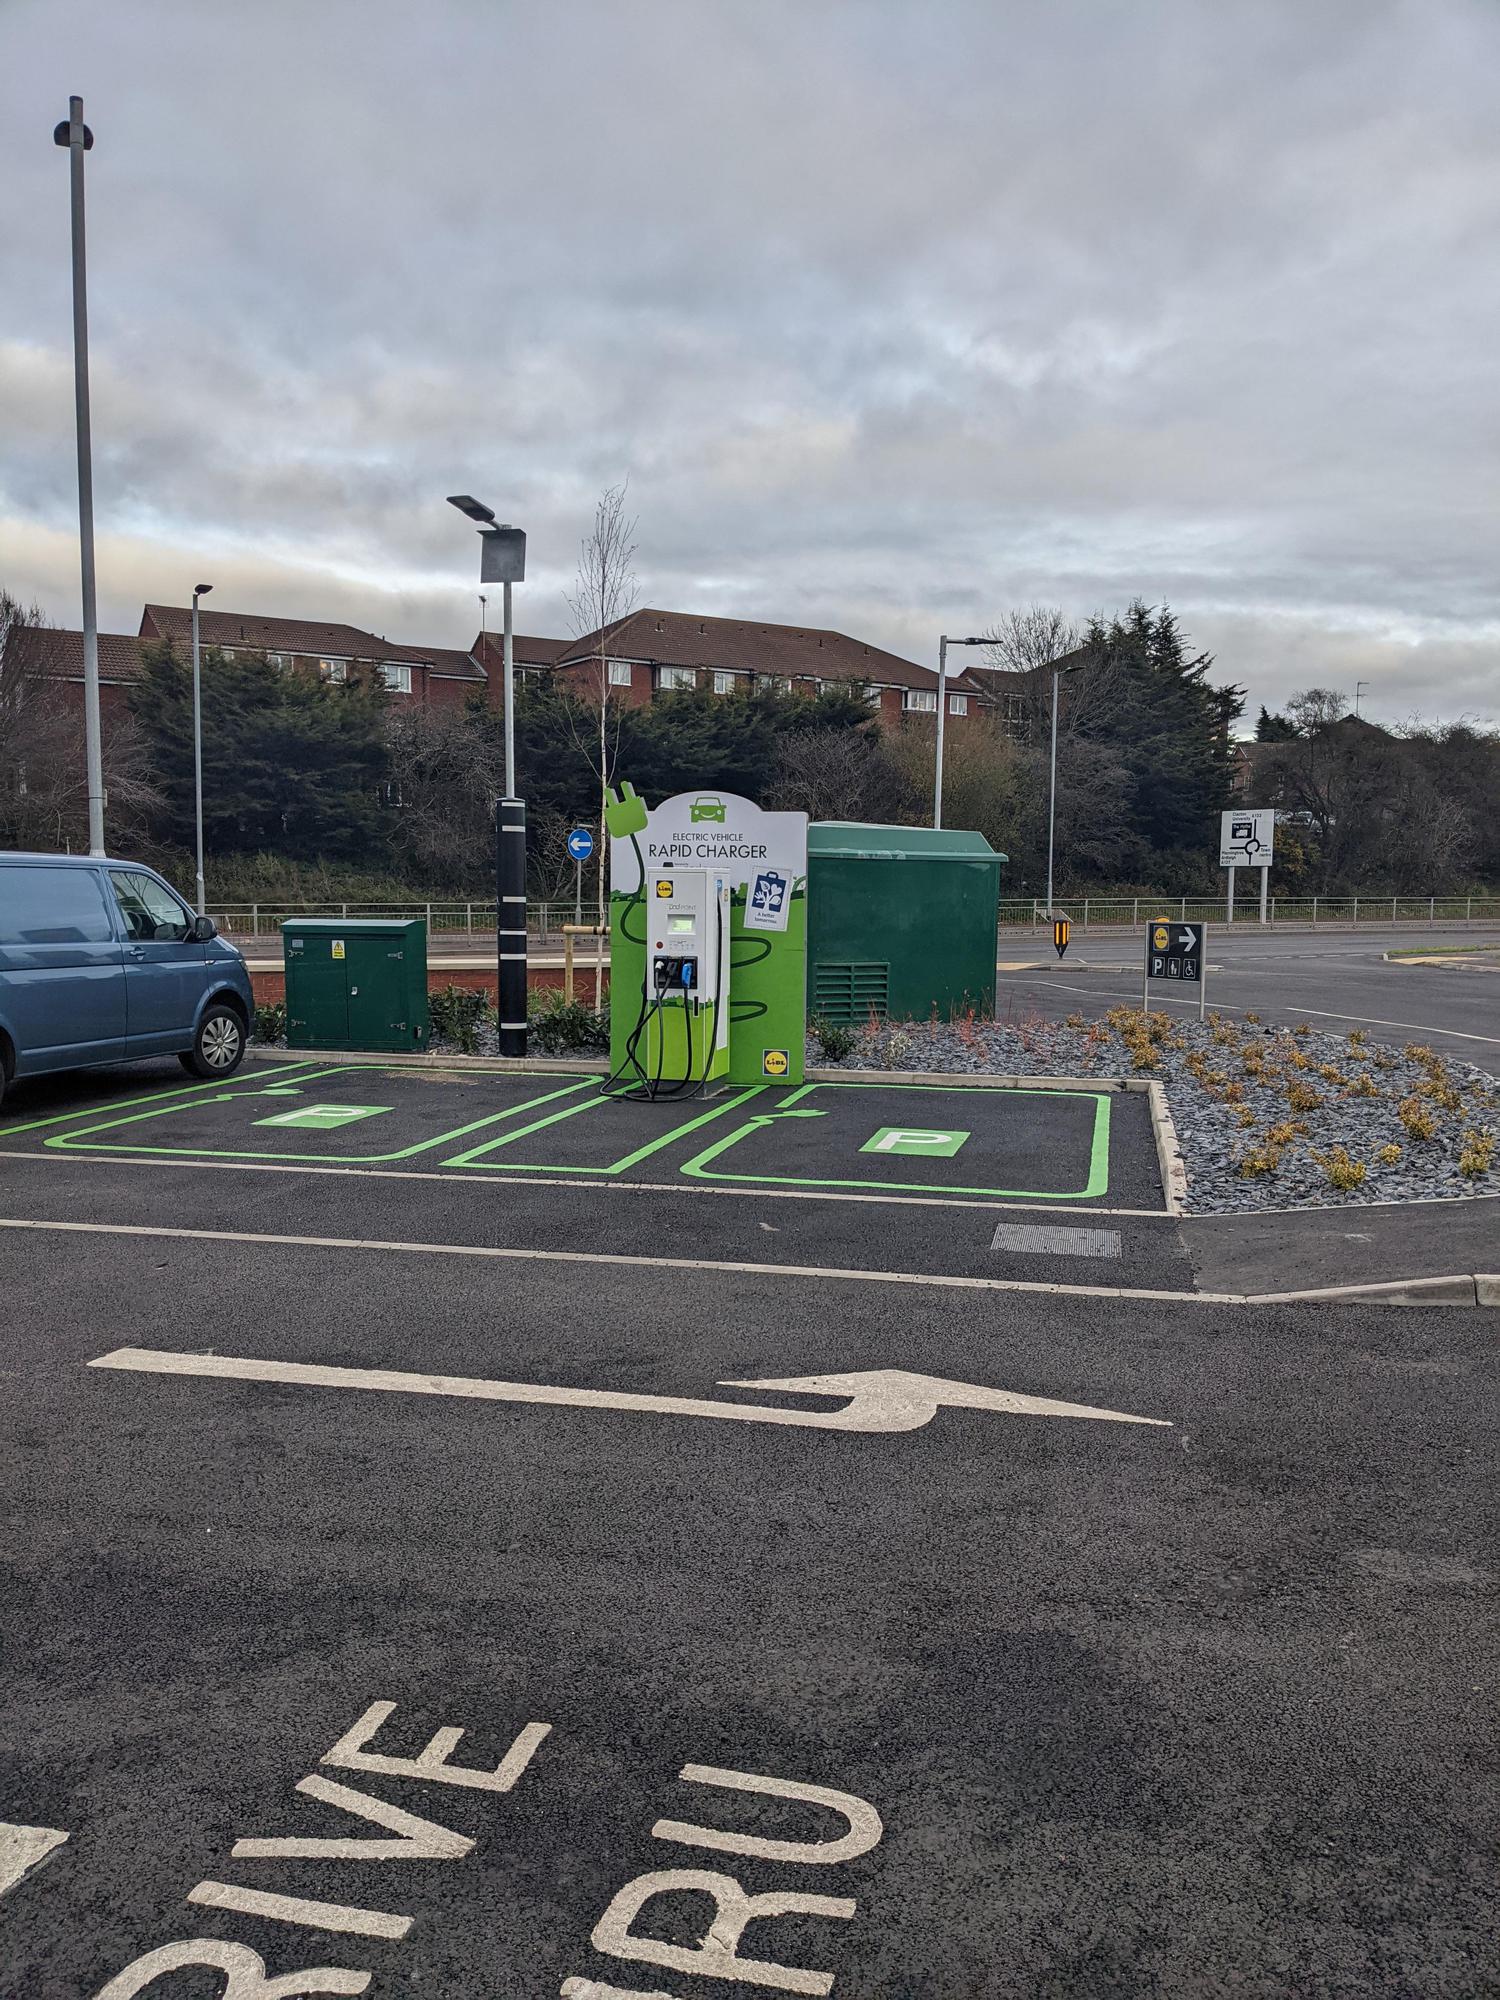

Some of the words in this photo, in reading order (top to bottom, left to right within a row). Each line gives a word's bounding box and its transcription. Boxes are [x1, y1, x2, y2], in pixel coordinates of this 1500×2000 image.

[672, 833, 709, 841] ELECTRIC
[711, 833, 743, 842] VEHICLE
[649, 844, 692, 858] RAPID
[696, 844, 767, 859] CHARGER
[1154, 959, 1162, 974] P
